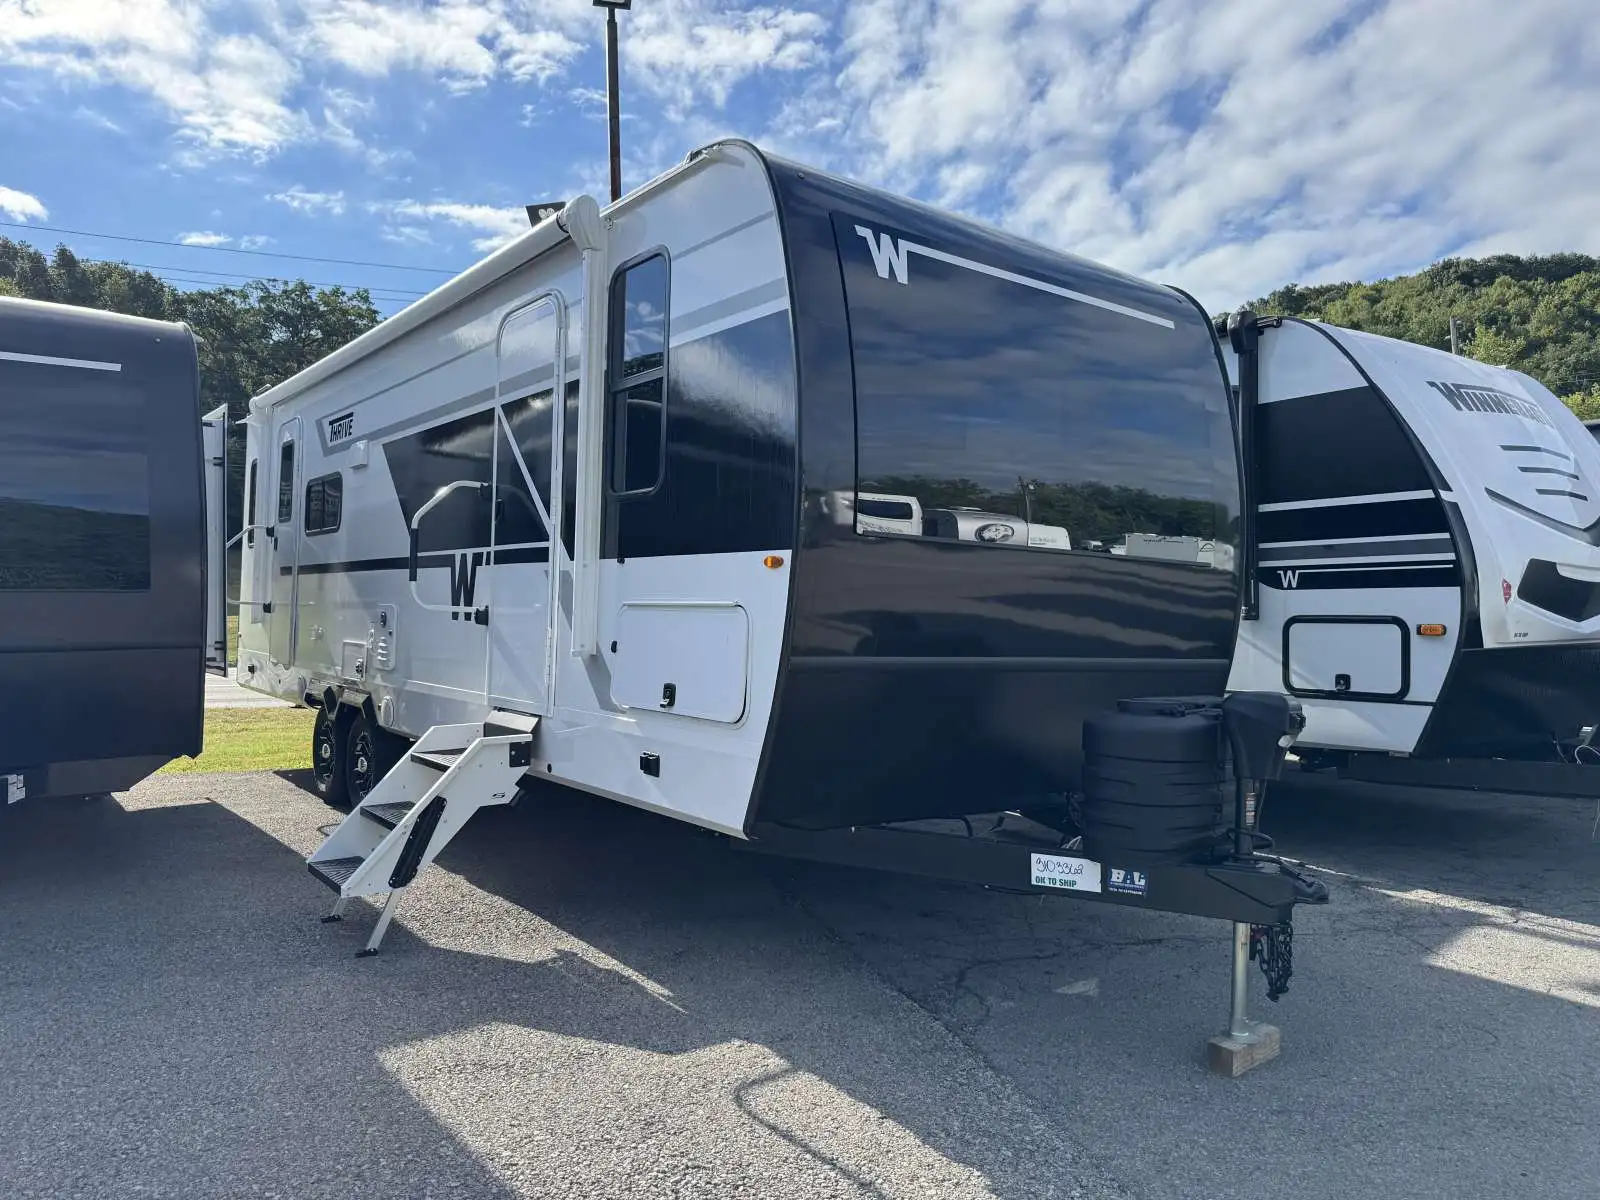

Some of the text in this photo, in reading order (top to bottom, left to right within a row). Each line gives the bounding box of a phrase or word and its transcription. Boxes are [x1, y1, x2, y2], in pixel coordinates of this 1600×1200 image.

[854, 224, 909, 285] W
[1425, 380, 1555, 430] WINNEBA
[328, 411, 354, 443] THRIVE
[1276, 569, 1300, 588] W
[1035, 875, 1077, 888] OK TO SHIP
